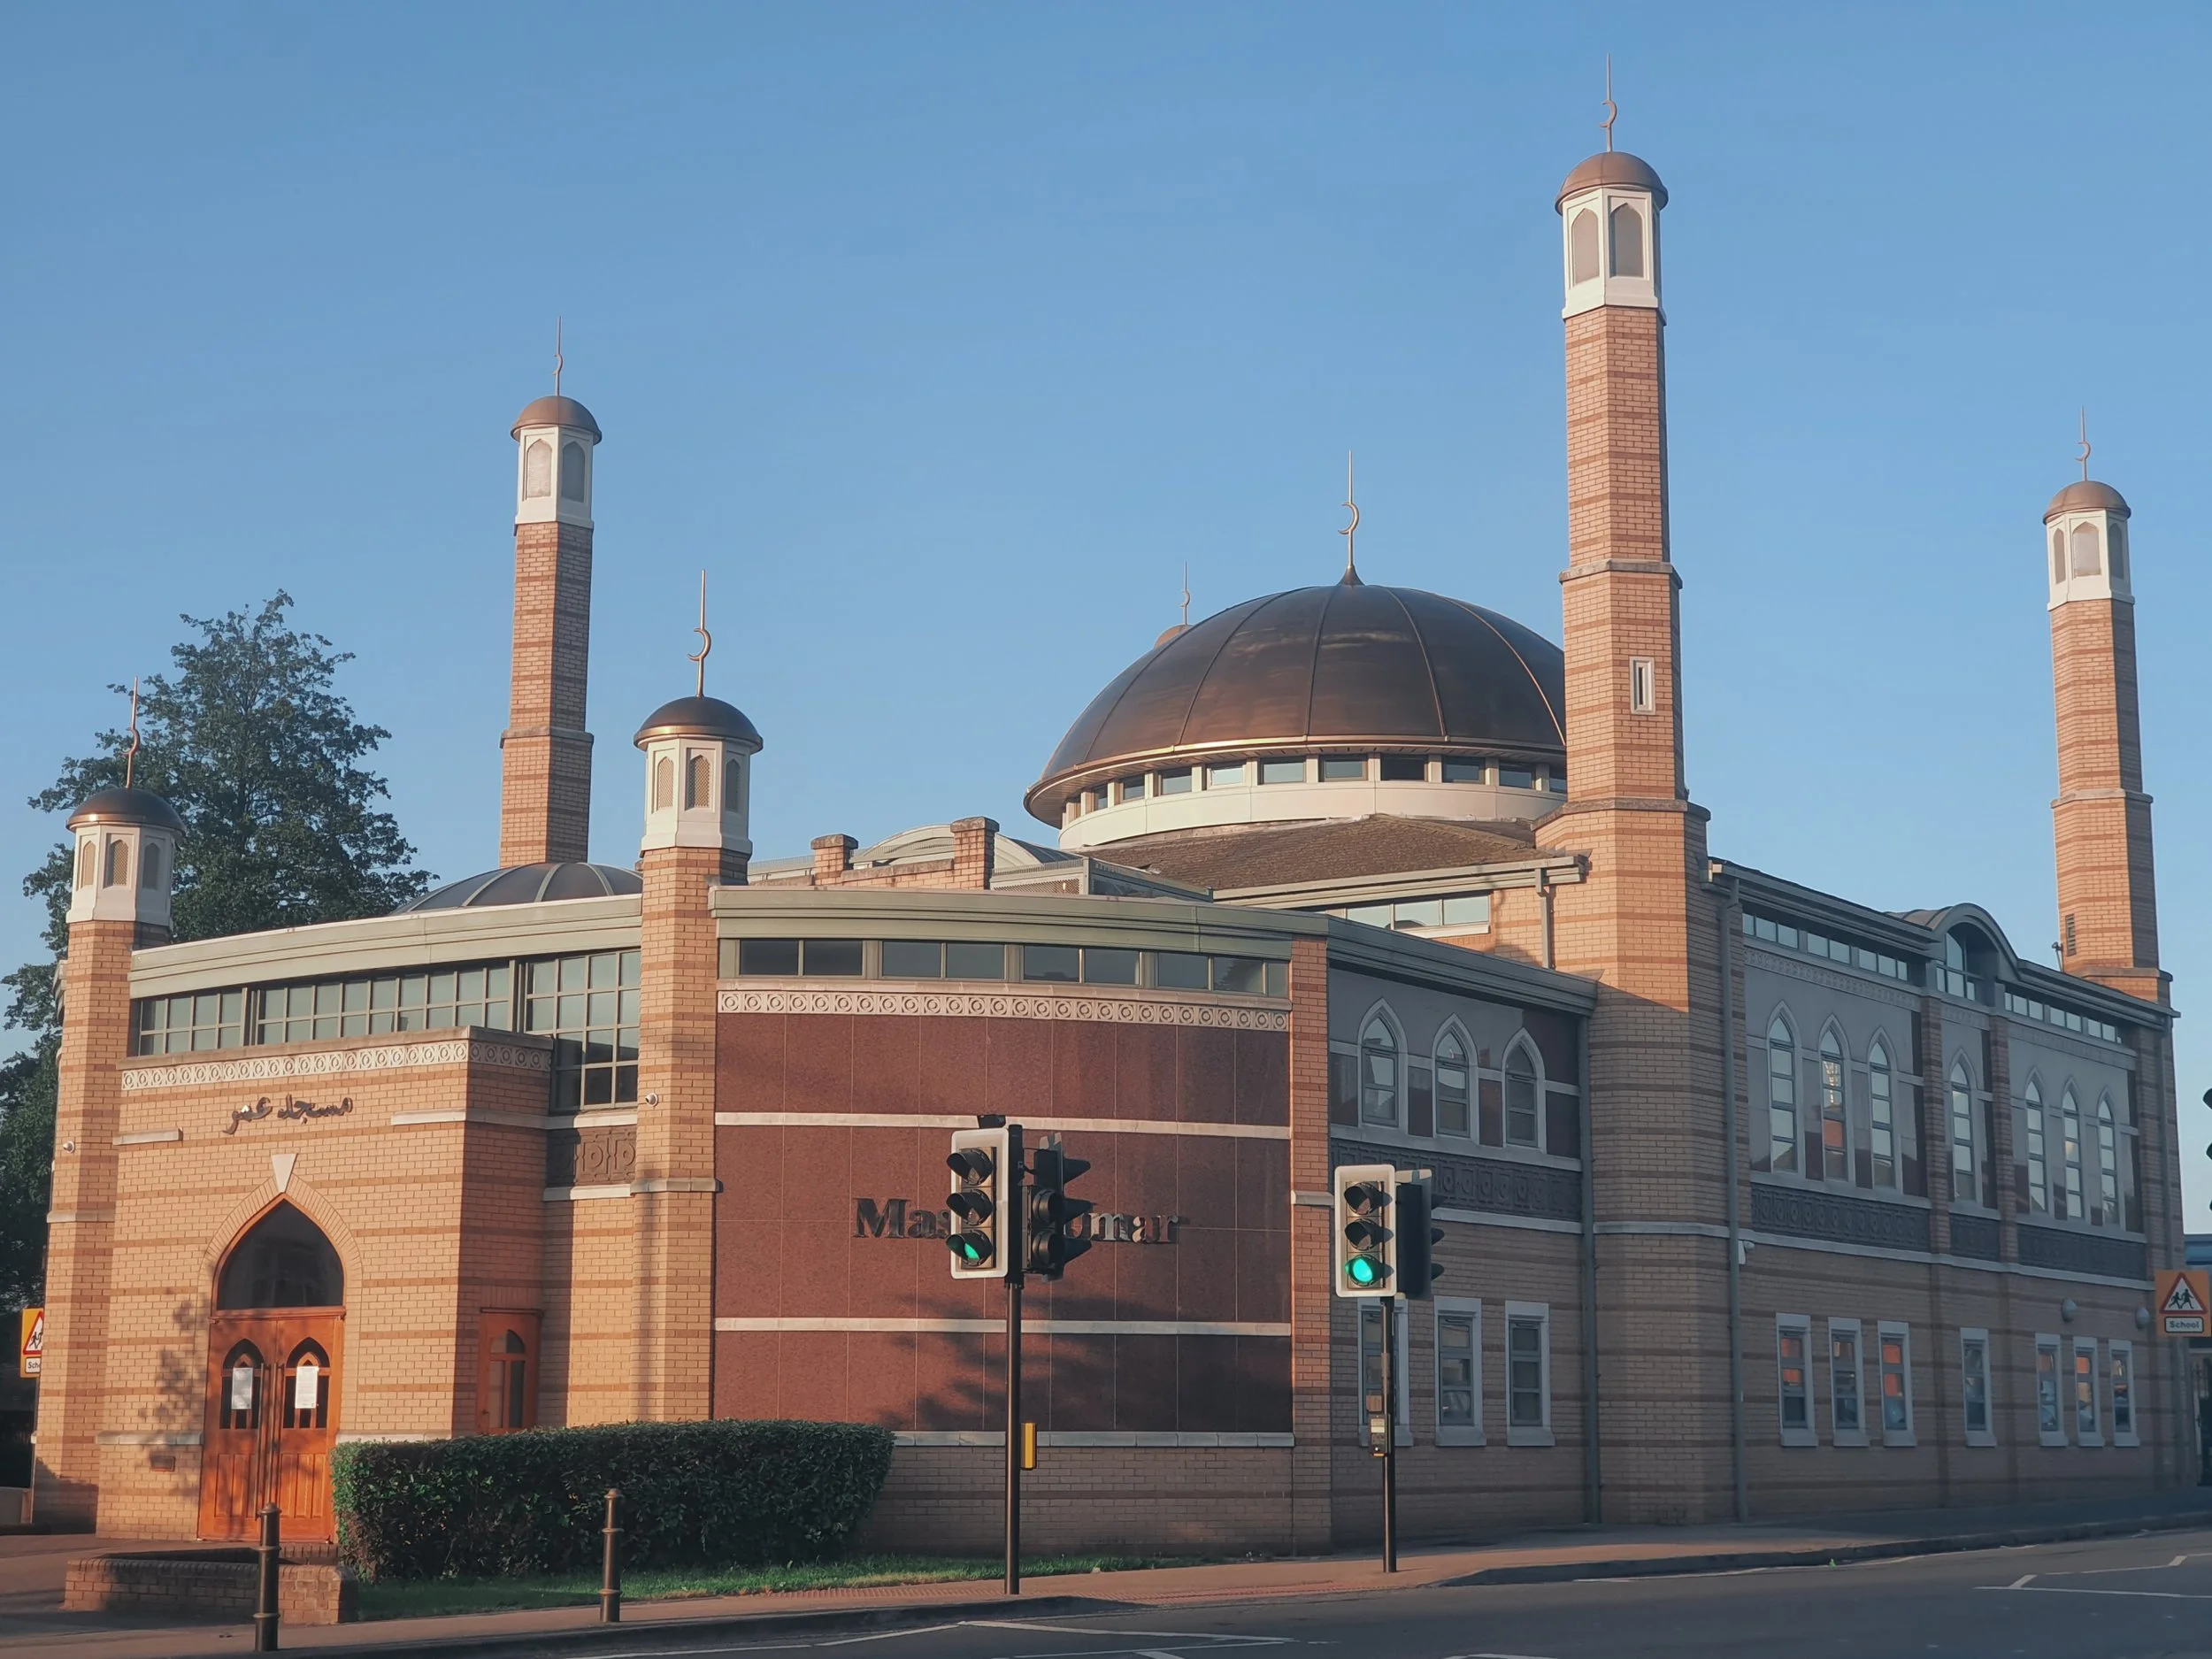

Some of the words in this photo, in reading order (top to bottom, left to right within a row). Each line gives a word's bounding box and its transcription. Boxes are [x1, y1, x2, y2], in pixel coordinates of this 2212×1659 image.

[222, 1096, 273, 1135] عمر
[277, 1093, 354, 1125] مسجد
[852, 1196, 951, 1239] Mas
[2169, 1319, 2200, 1329] School
